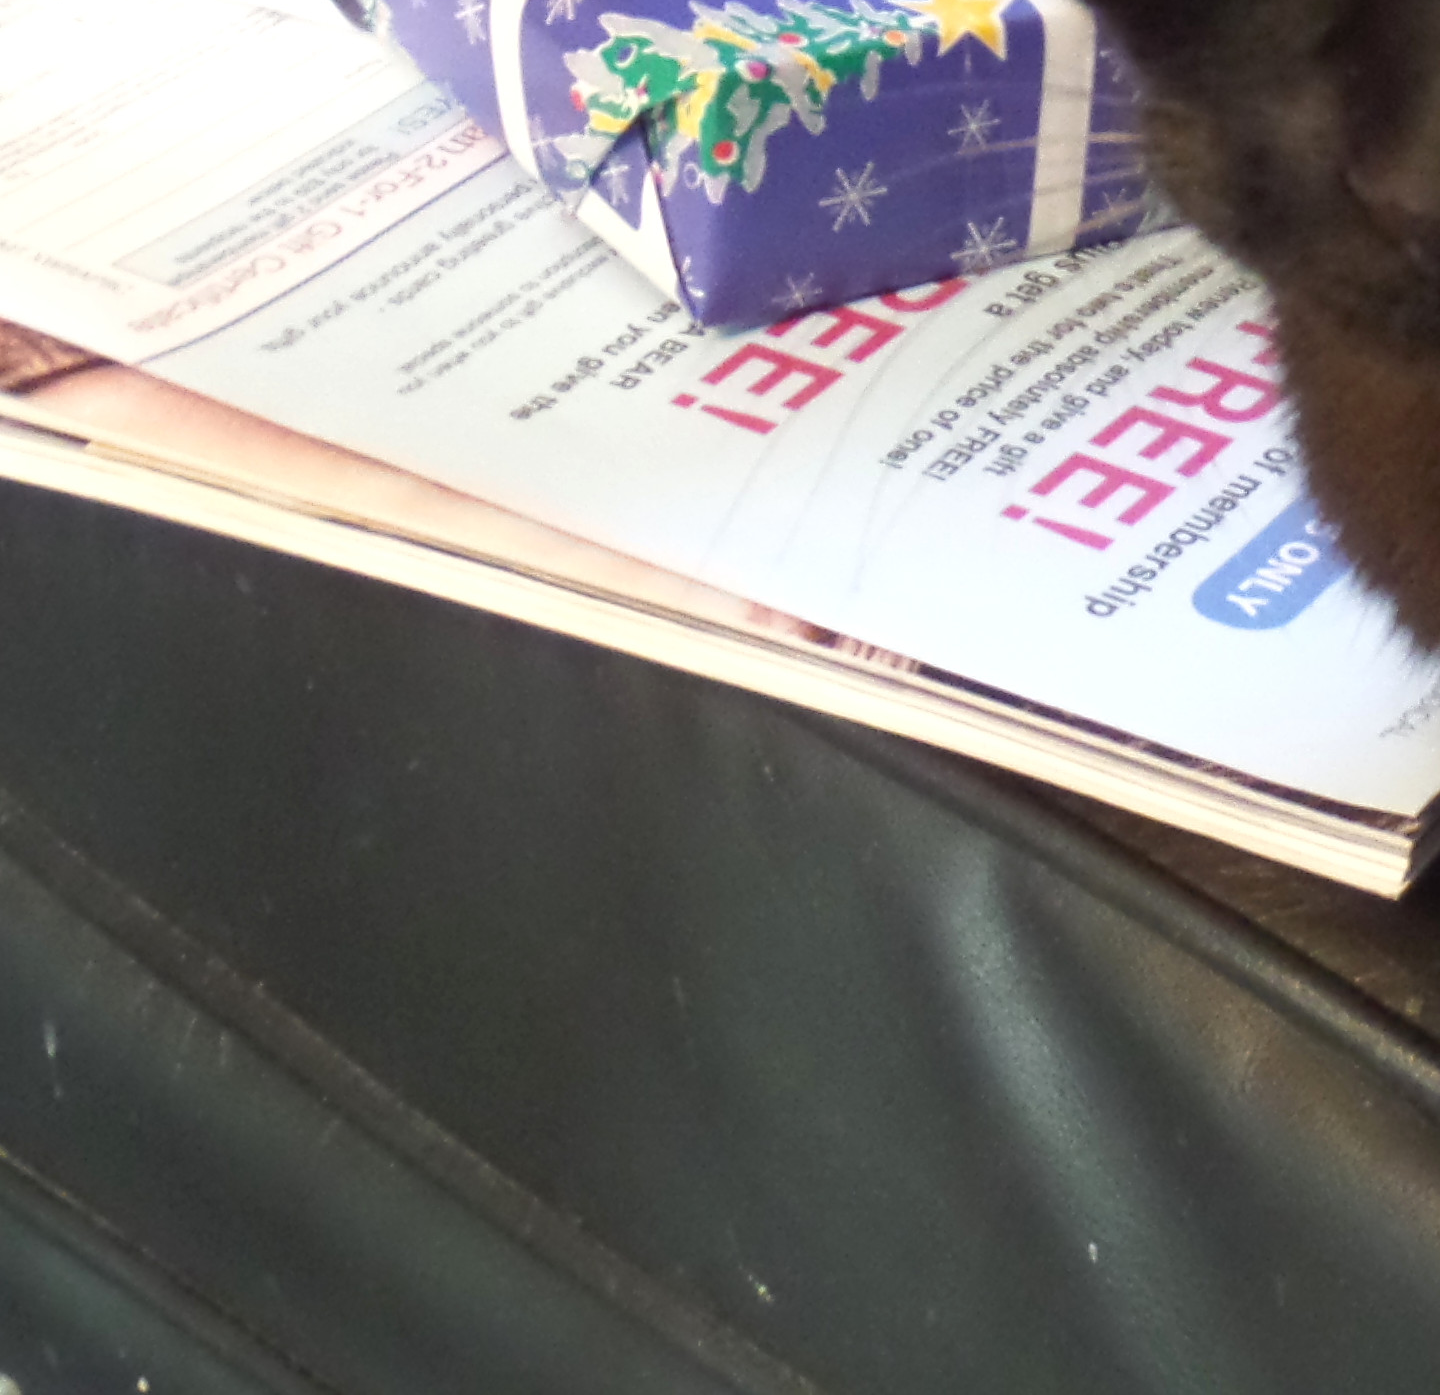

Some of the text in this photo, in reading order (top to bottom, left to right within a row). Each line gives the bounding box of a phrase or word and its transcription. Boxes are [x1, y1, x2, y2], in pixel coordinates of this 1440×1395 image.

[1005, 269, 1059, 306] get
[983, 301, 1014, 318] a
[1045, 315, 1089, 341] for
[601, 321, 651, 357] you
[1009, 335, 1056, 366] the
[1118, 318, 1195, 364] today,
[550, 356, 605, 393] give
[609, 339, 689, 391] BEAR
[920, 264, 1215, 482] membership absolutely FREE!
[1085, 363, 1132, 398] and
[955, 361, 1015, 409] price
[930, 408, 962, 432] of
[1040, 393, 1091, 432] give
[879, 427, 936, 470] one!
[1022, 430, 1047, 446] a
[982, 442, 1030, 478] gift
[1085, 446, 1295, 619] of membership
[1225, 540, 1322, 617] ONLY
